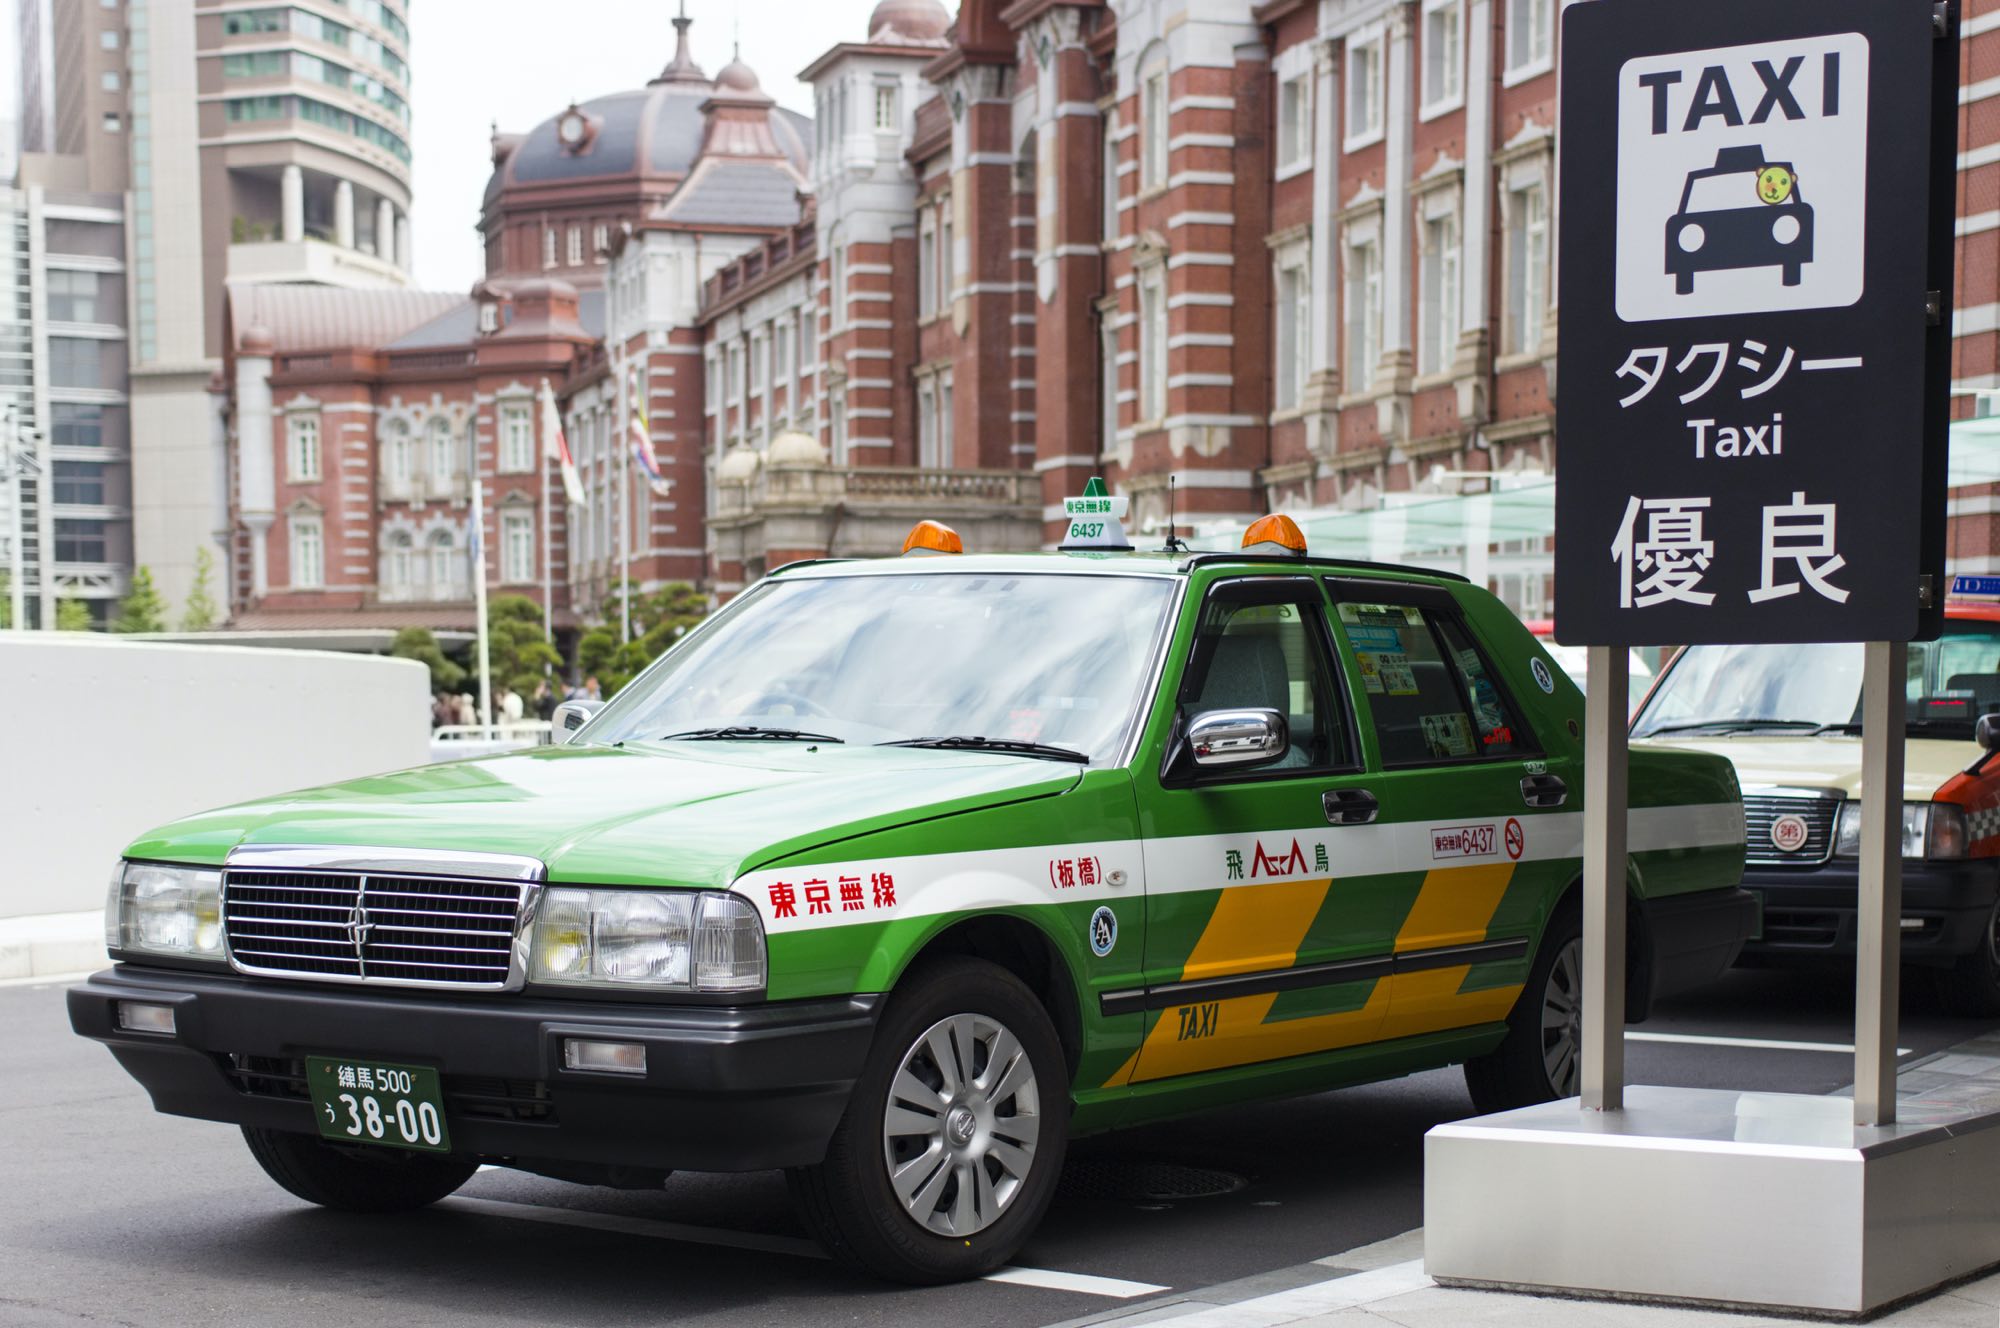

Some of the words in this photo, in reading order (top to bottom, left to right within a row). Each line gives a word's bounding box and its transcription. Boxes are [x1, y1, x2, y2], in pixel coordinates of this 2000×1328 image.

[1639, 51, 1840, 136] TAXI
[1614, 339, 1863, 409] タクシー
[1686, 413, 1783, 459] Taxi
[1066, 500, 1112, 514] 東京無線
[1071, 523, 1105, 538] 6437
[1610, 491, 1851, 609] 優良
[1225, 849, 1244, 880] 飛
[1314, 842, 1329, 872] 鳥
[767, 872, 897, 919] 東京無線
[1177, 1002, 1220, 1041] TAXI
[376, 1068, 411, 1094] 500
[324, 1102, 336, 1123] う
[338, 1093, 441, 1145] 38-00
